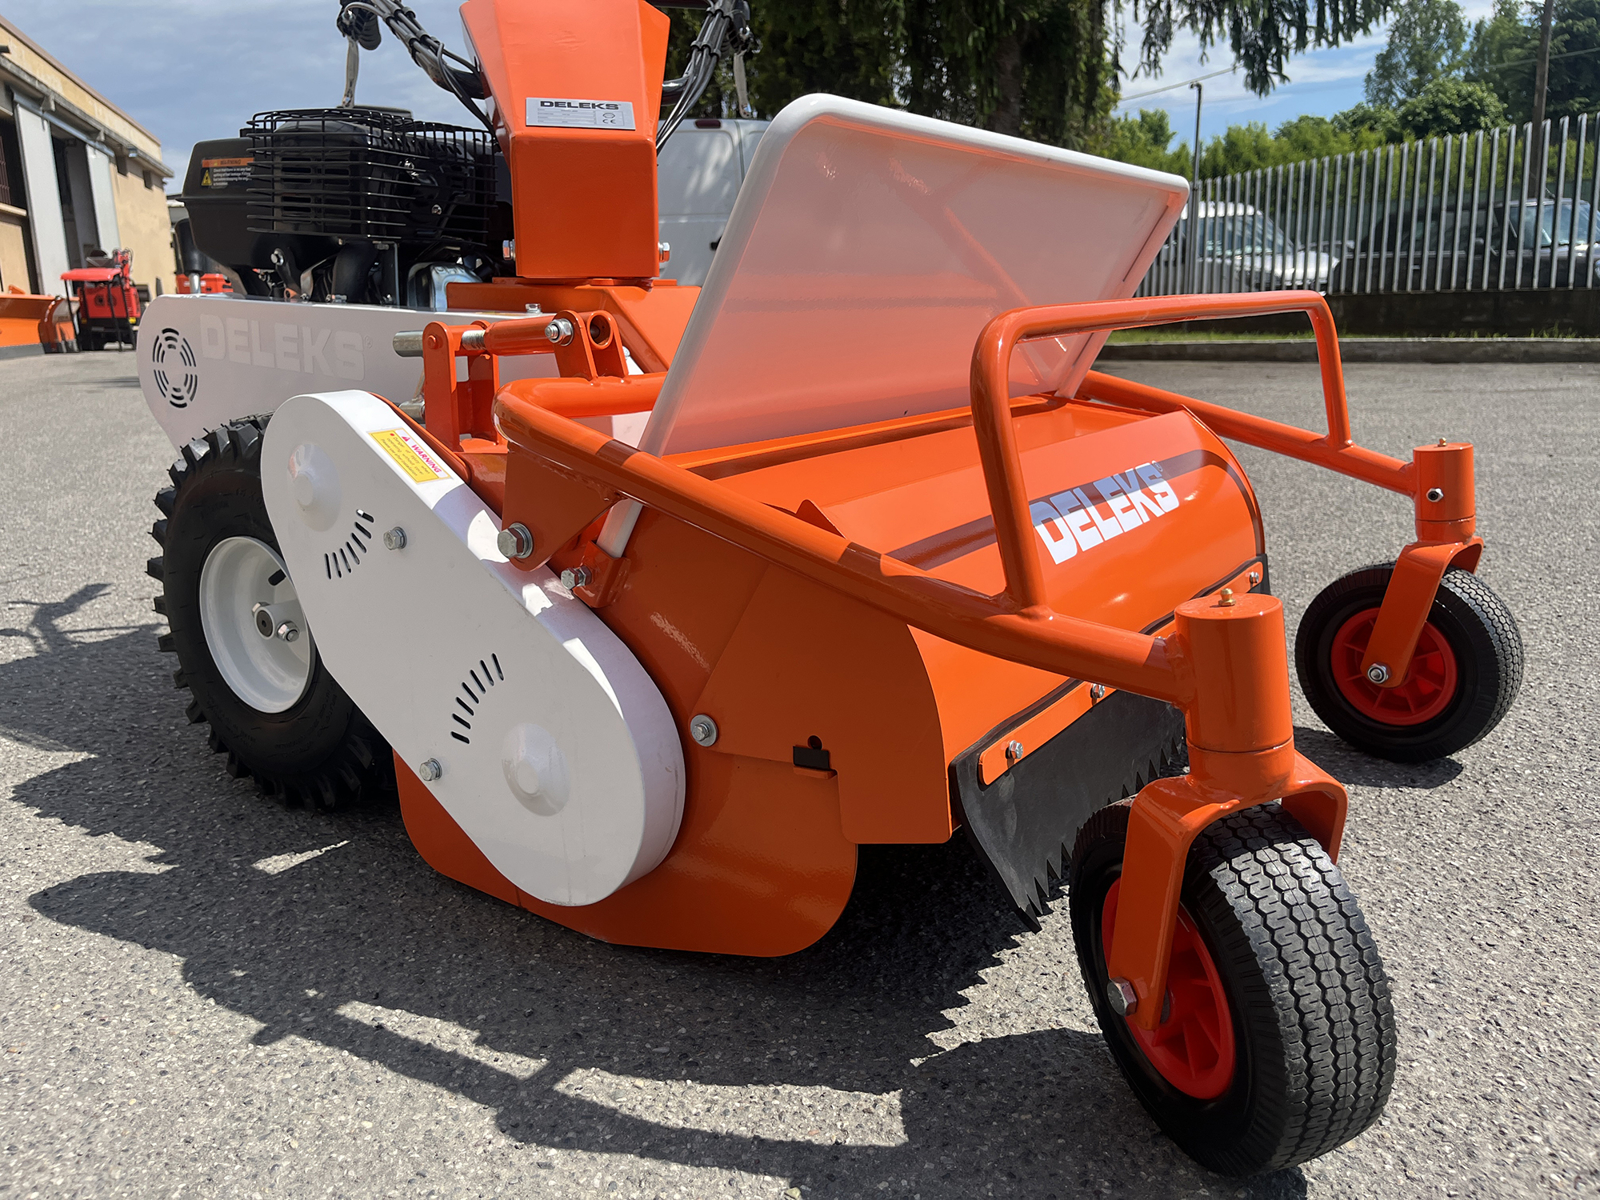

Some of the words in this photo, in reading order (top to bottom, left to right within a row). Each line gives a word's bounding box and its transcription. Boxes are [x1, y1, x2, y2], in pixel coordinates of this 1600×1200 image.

[540, 100, 619, 110] DELEKS
[200, 314, 365, 381] DELEKS
[411, 444, 442, 473] WARNING
[1029, 462, 1179, 565] DELEKS
